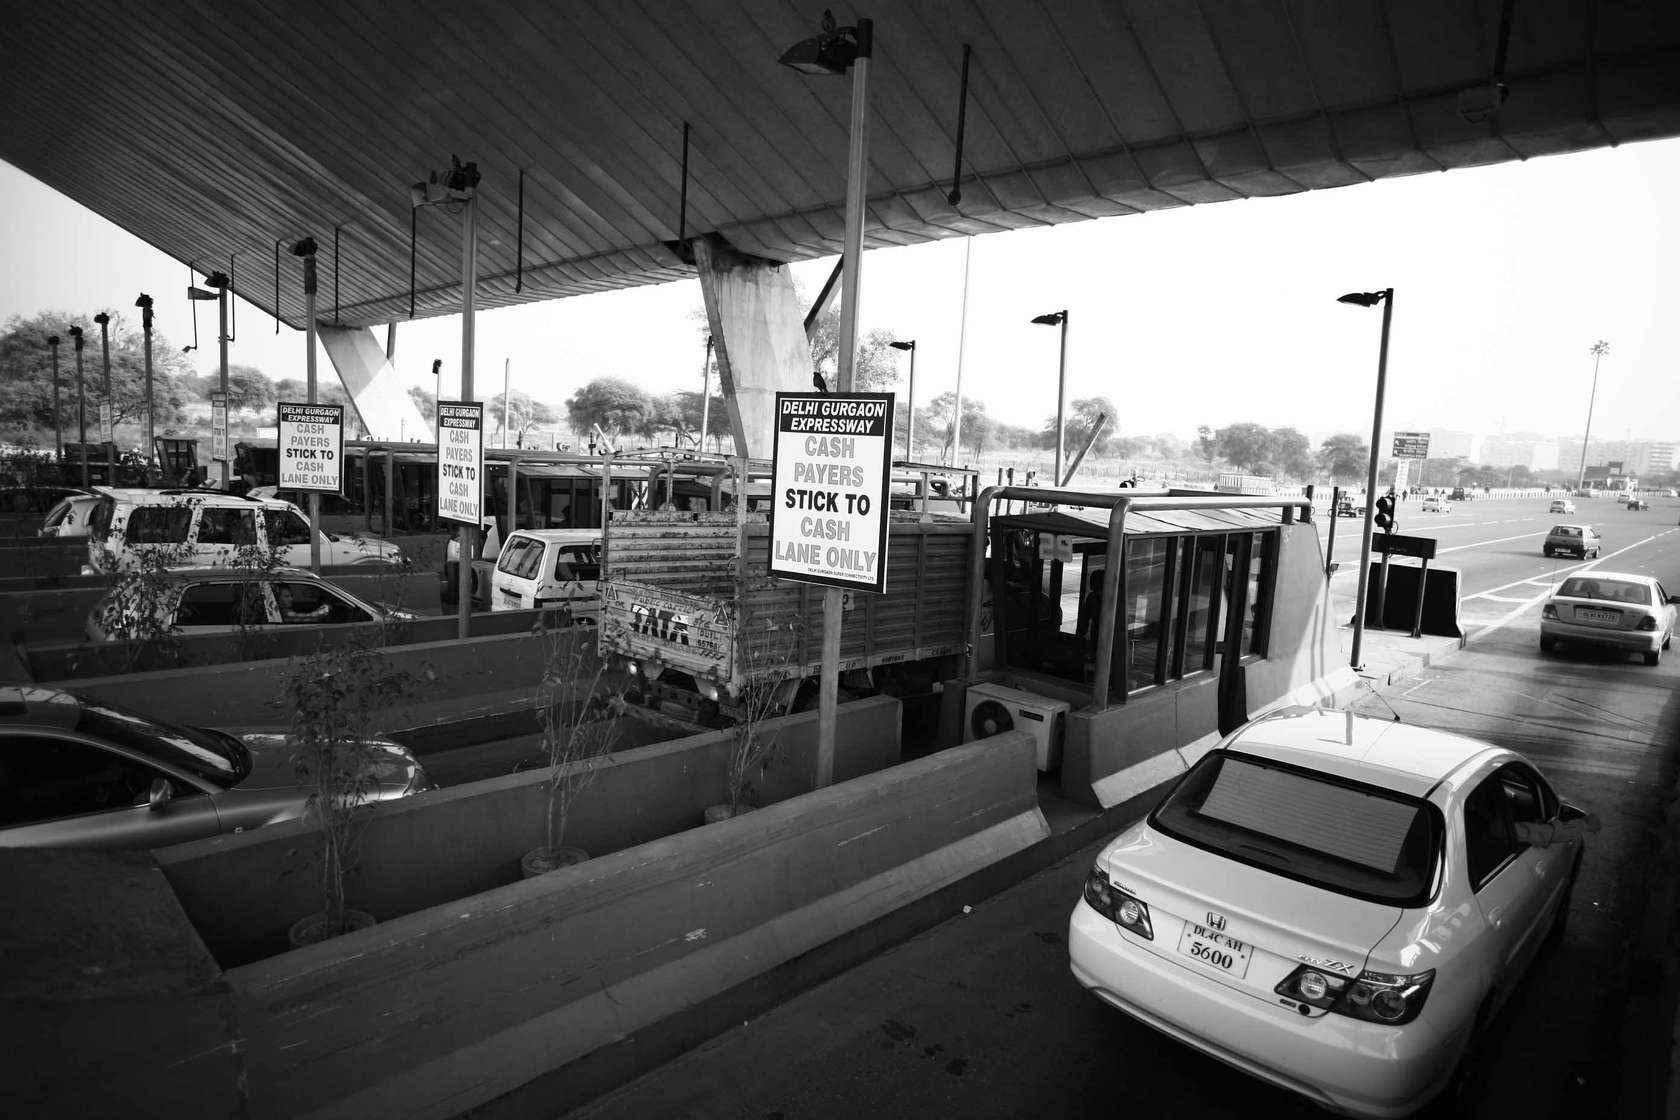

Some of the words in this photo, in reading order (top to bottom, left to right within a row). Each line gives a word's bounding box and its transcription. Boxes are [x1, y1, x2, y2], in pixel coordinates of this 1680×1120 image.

[305, 408, 339, 417] GURGAON
[782, 401, 819, 415] DELHI
[821, 402, 885, 417] GURGAON
[287, 415, 334, 423] EXPRESSWAY
[790, 417, 874, 434] EXPRESSWAY
[296, 423, 325, 435] CASH
[449, 430, 469, 444] CASH
[290, 435, 330, 447] PAYERS
[804, 435, 855, 459] CASH
[286, 448, 317, 459] STICK
[320, 449, 334, 460] TO
[445, 447, 473, 463] PAYERS
[295, 461, 324, 473] CASH
[442, 463, 464, 479] STICK
[465, 466, 476, 481] TO
[793, 462, 864, 488] PAYERS
[281, 473, 309, 484] LANE
[311, 475, 338, 485] ONLY
[449, 481, 469, 498] CASH
[439, 496, 458, 513] LANE
[459, 500, 479, 517] ONLY
[785, 488, 839, 513] STICK
[845, 493, 871, 516] TO
[800, 516, 851, 542] CASH
[775, 540, 821, 565] LANE
[826, 546, 877, 572] ONLY
[1190, 941, 1234, 970] 5600
